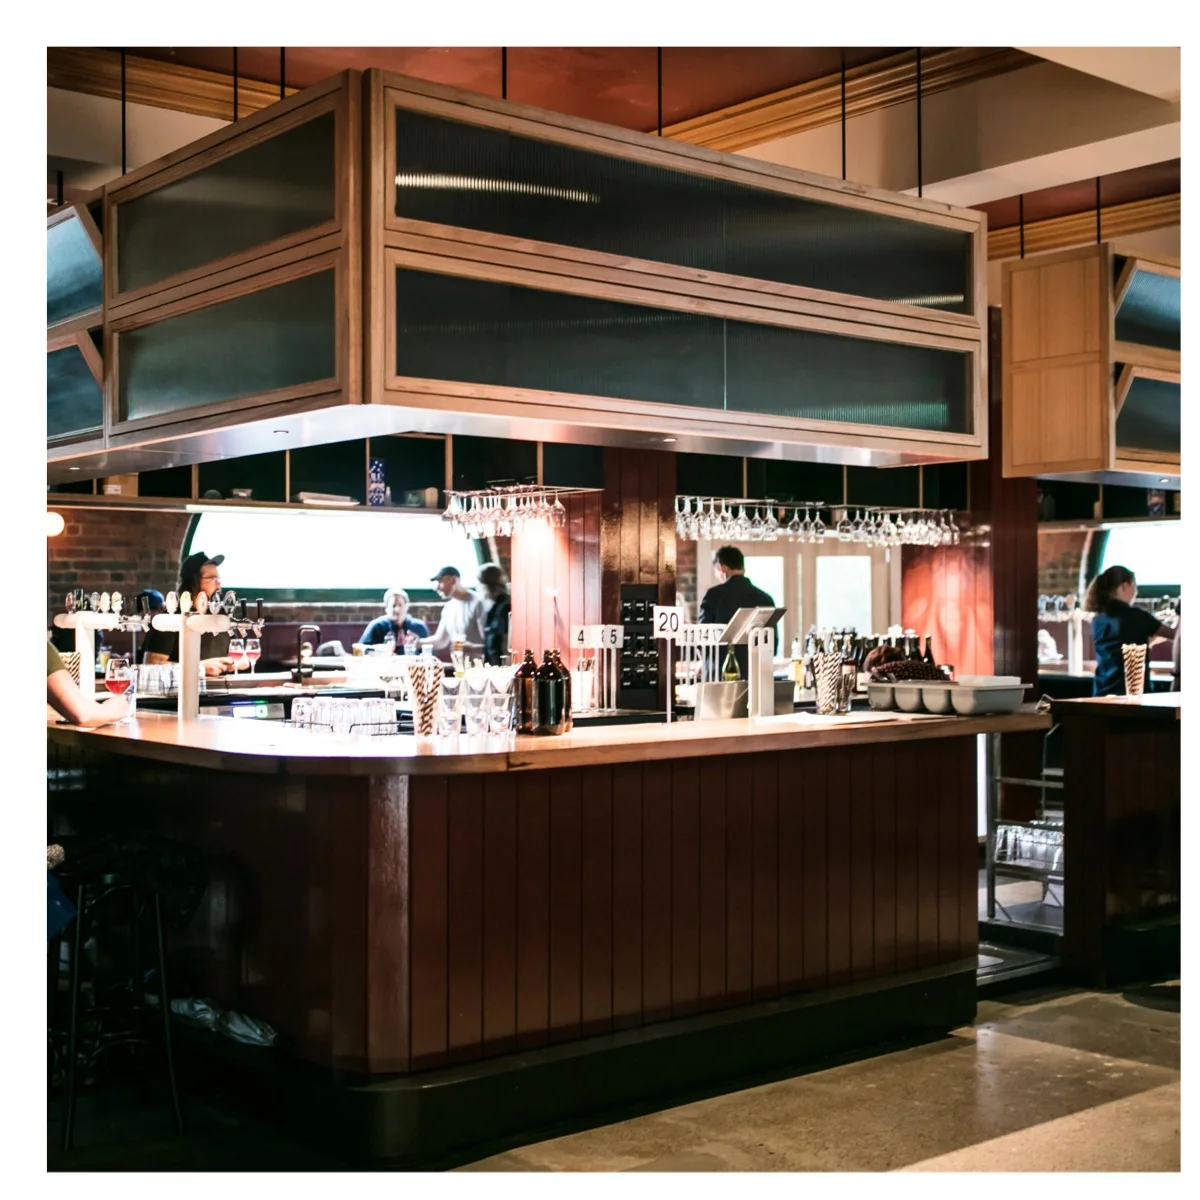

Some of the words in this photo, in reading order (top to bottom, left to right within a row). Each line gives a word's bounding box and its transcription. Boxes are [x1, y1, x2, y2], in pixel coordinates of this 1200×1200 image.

[659, 612, 679, 632] 20
[577, 629, 585, 644] 4
[610, 629, 617, 644] 5
[684, 629, 695, 643] 11
